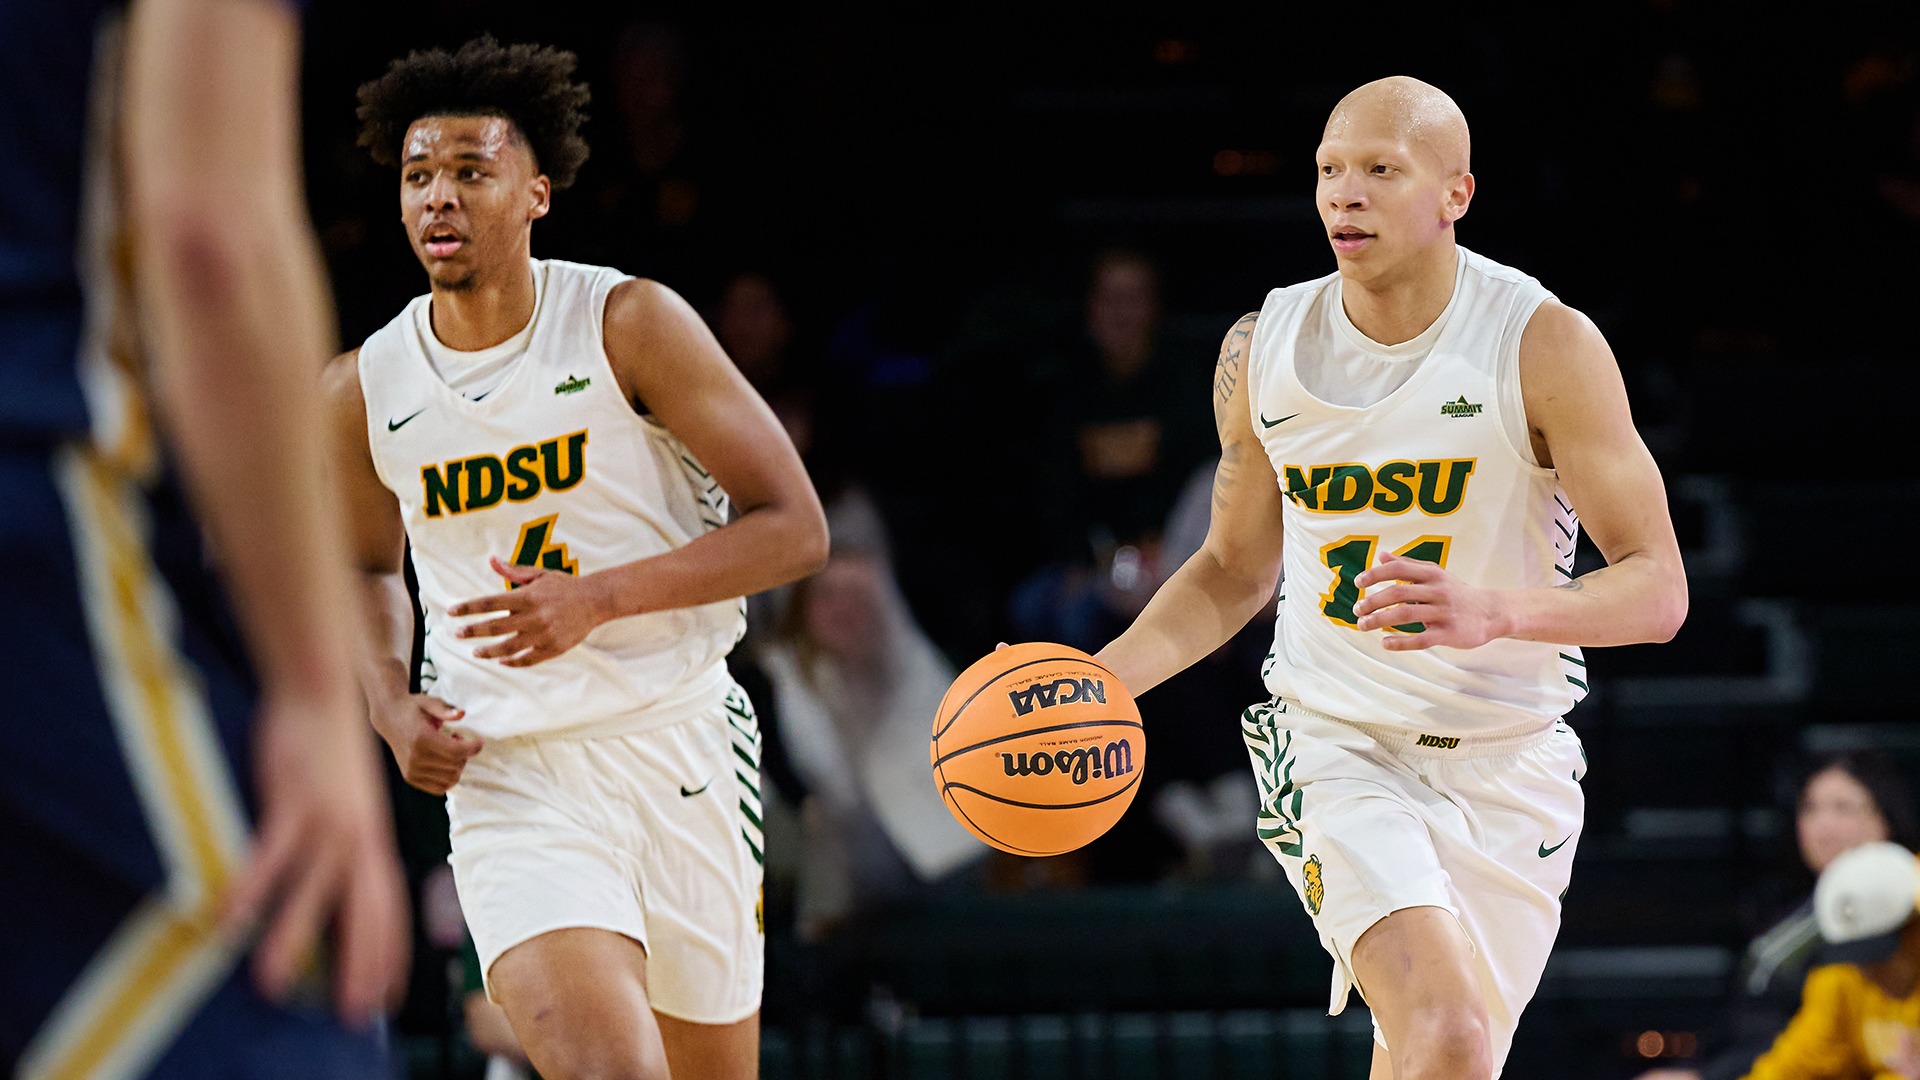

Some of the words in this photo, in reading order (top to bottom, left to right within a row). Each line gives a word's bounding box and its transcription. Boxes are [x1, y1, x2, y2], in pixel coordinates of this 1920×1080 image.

[1440, 403, 1483, 415] SUMMIT
[420, 428, 589, 519] NDSU
[1283, 456, 1478, 517] NDSU
[503, 512, 579, 592] 4
[1006, 677, 1033, 689] BALL
[1008, 677, 1107, 717] NCAA
[1080, 735, 1103, 743] INDOOR
[1415, 733, 1461, 750] NDSU
[1001, 738, 1134, 786] Wilson
